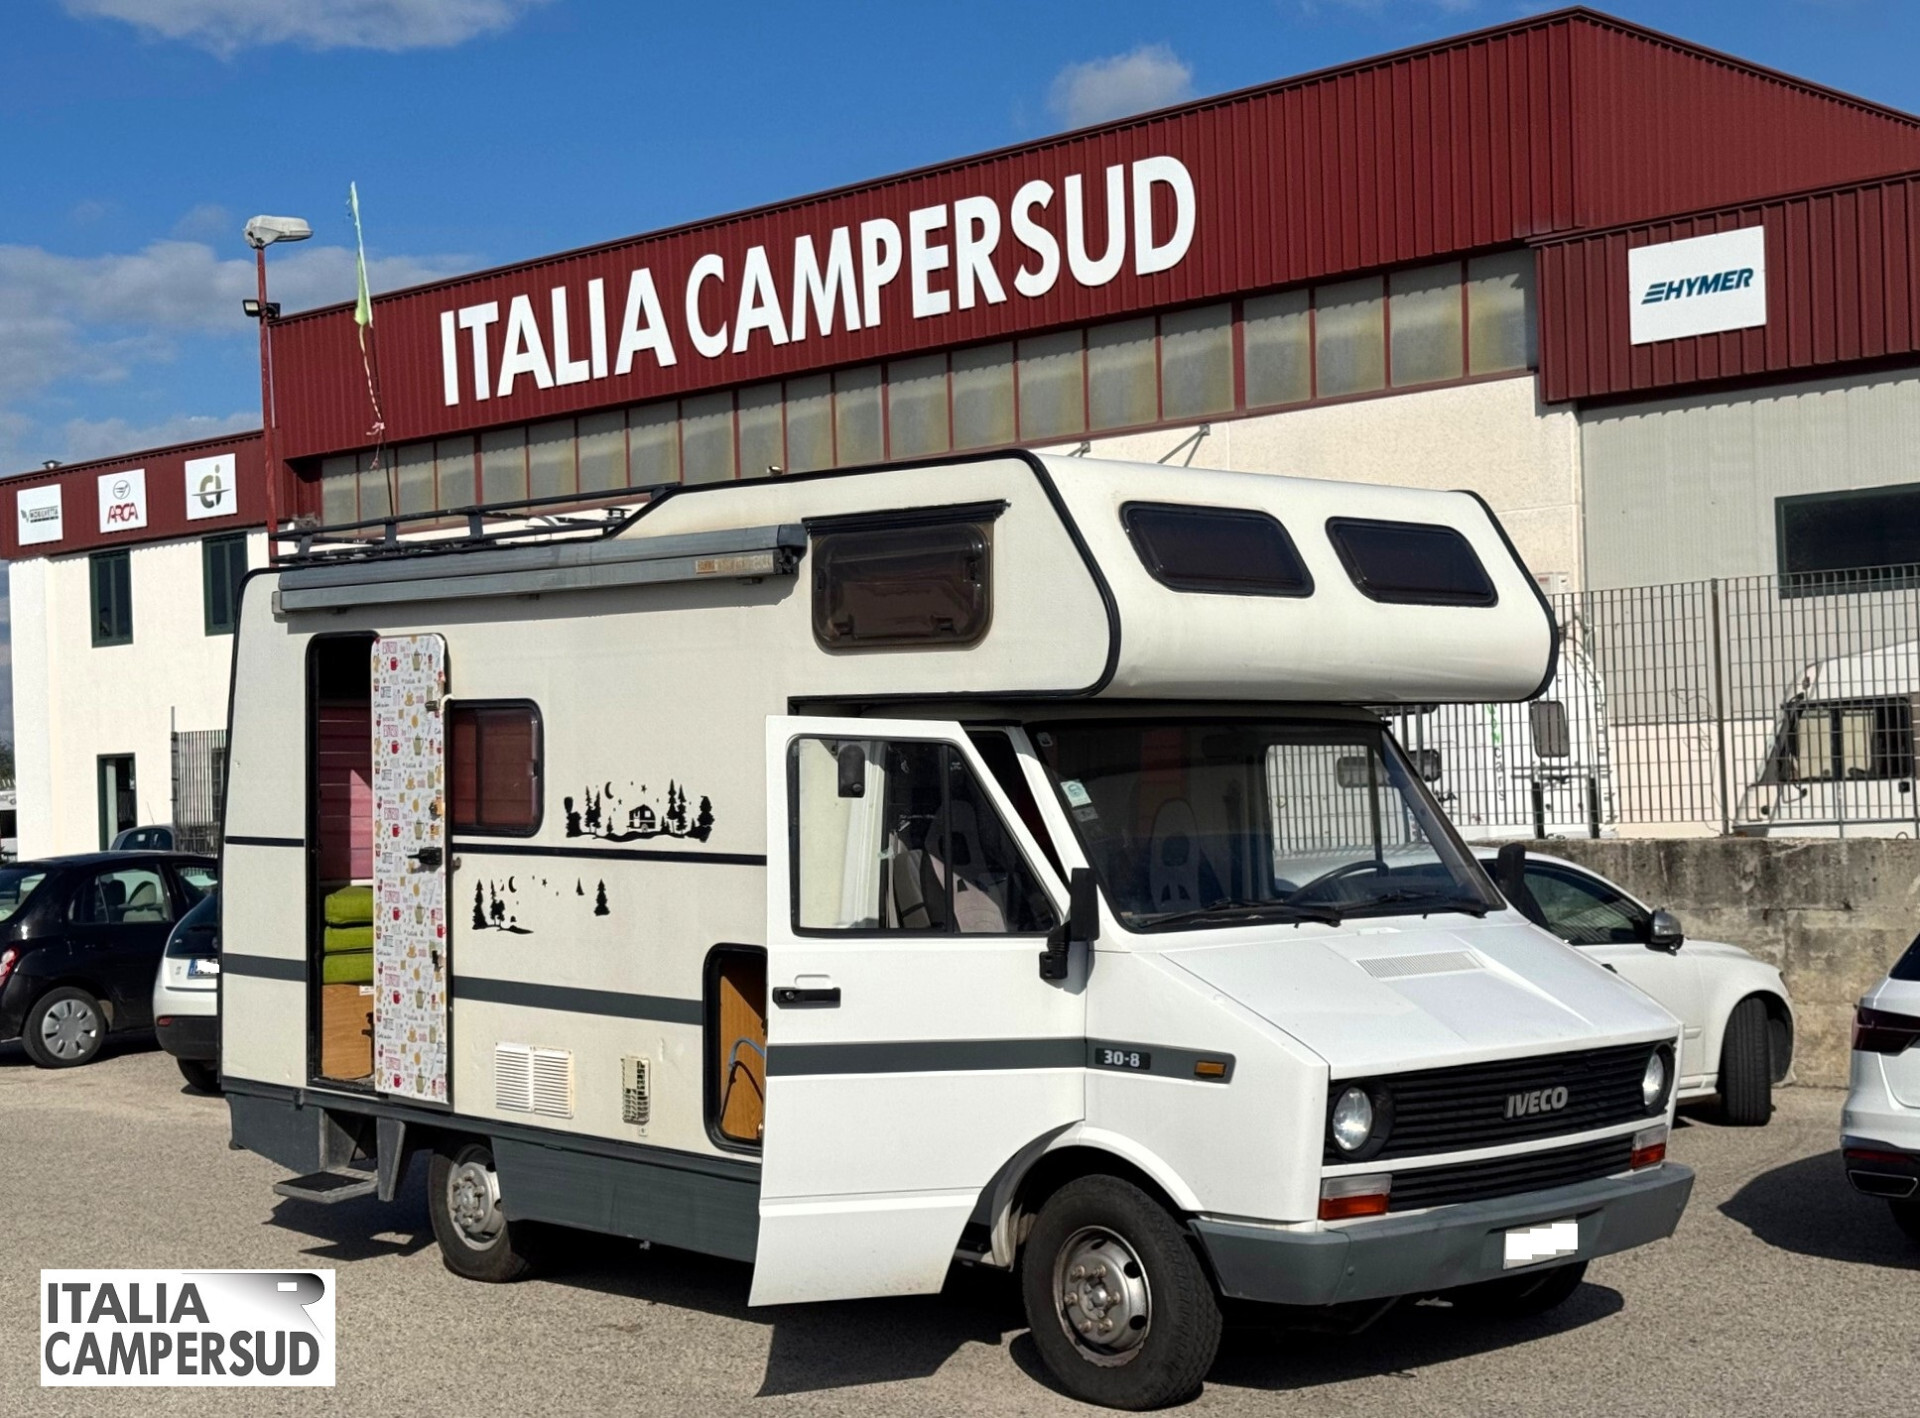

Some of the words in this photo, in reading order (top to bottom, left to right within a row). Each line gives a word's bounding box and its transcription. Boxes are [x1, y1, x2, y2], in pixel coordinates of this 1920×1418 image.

[440, 268, 678, 406] ITALIA
[685, 155, 1197, 359] CAMPERSUD
[1664, 268, 1754, 301] HYMER
[107, 502, 139, 525] ARCA
[1104, 1050, 1140, 1067] 30-8
[1506, 1086, 1568, 1118] IVECO
